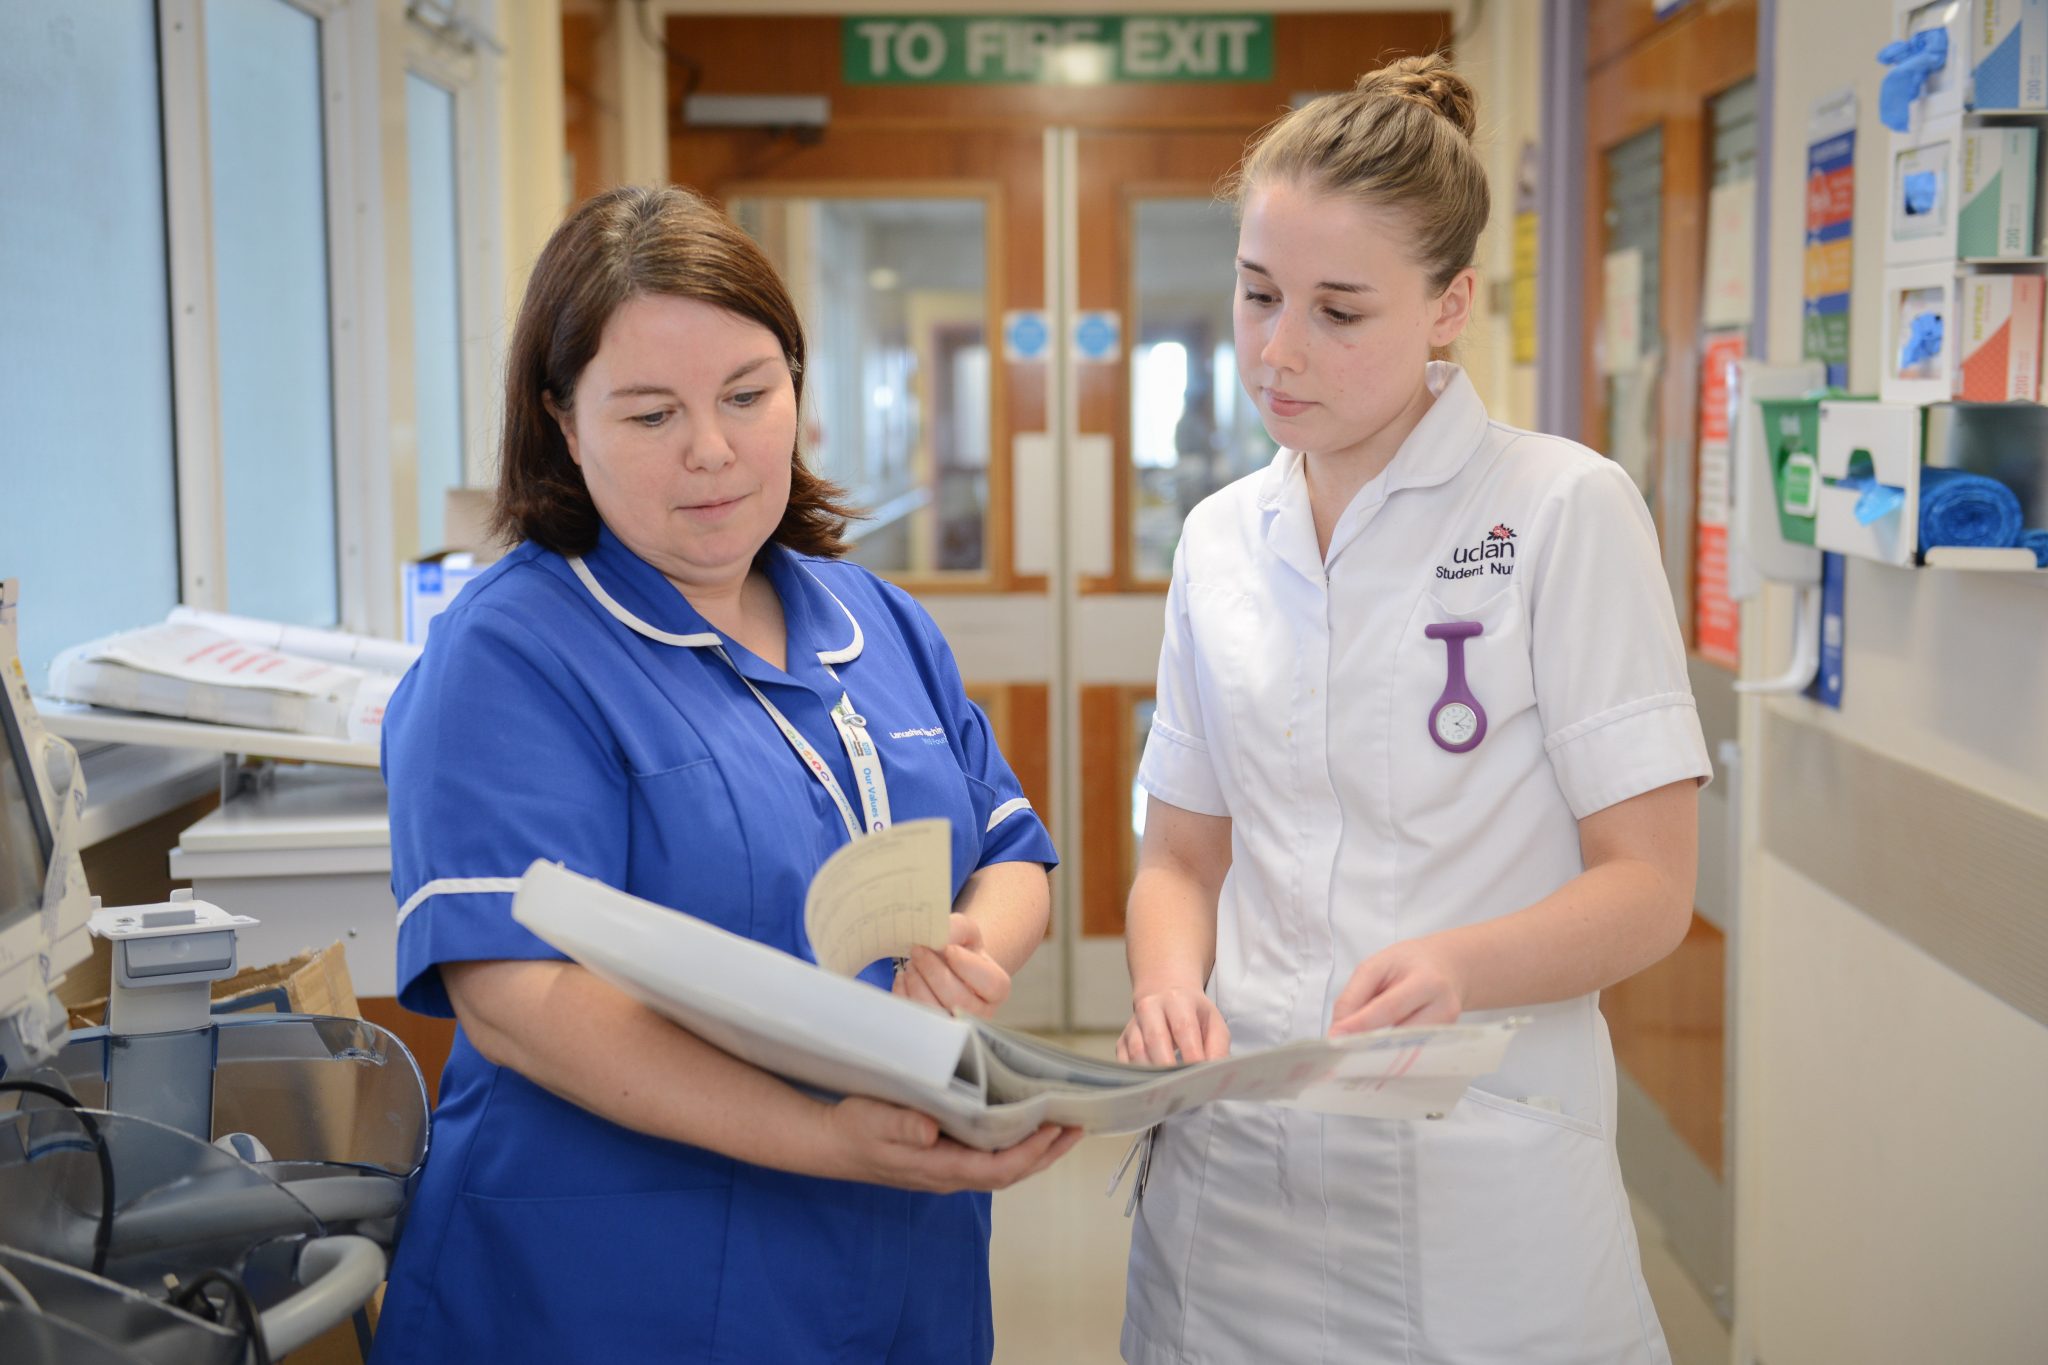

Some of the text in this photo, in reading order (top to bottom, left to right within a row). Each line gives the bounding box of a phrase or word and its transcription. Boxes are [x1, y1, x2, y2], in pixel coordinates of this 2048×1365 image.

[857, 20, 947, 77] TO
[1122, 19, 1260, 75] EXIT
[1453, 540, 1514, 563] uclan
[1435, 565, 1484, 580] Student
[863, 767, 872, 785] Our
[867, 785, 879, 818] Values
